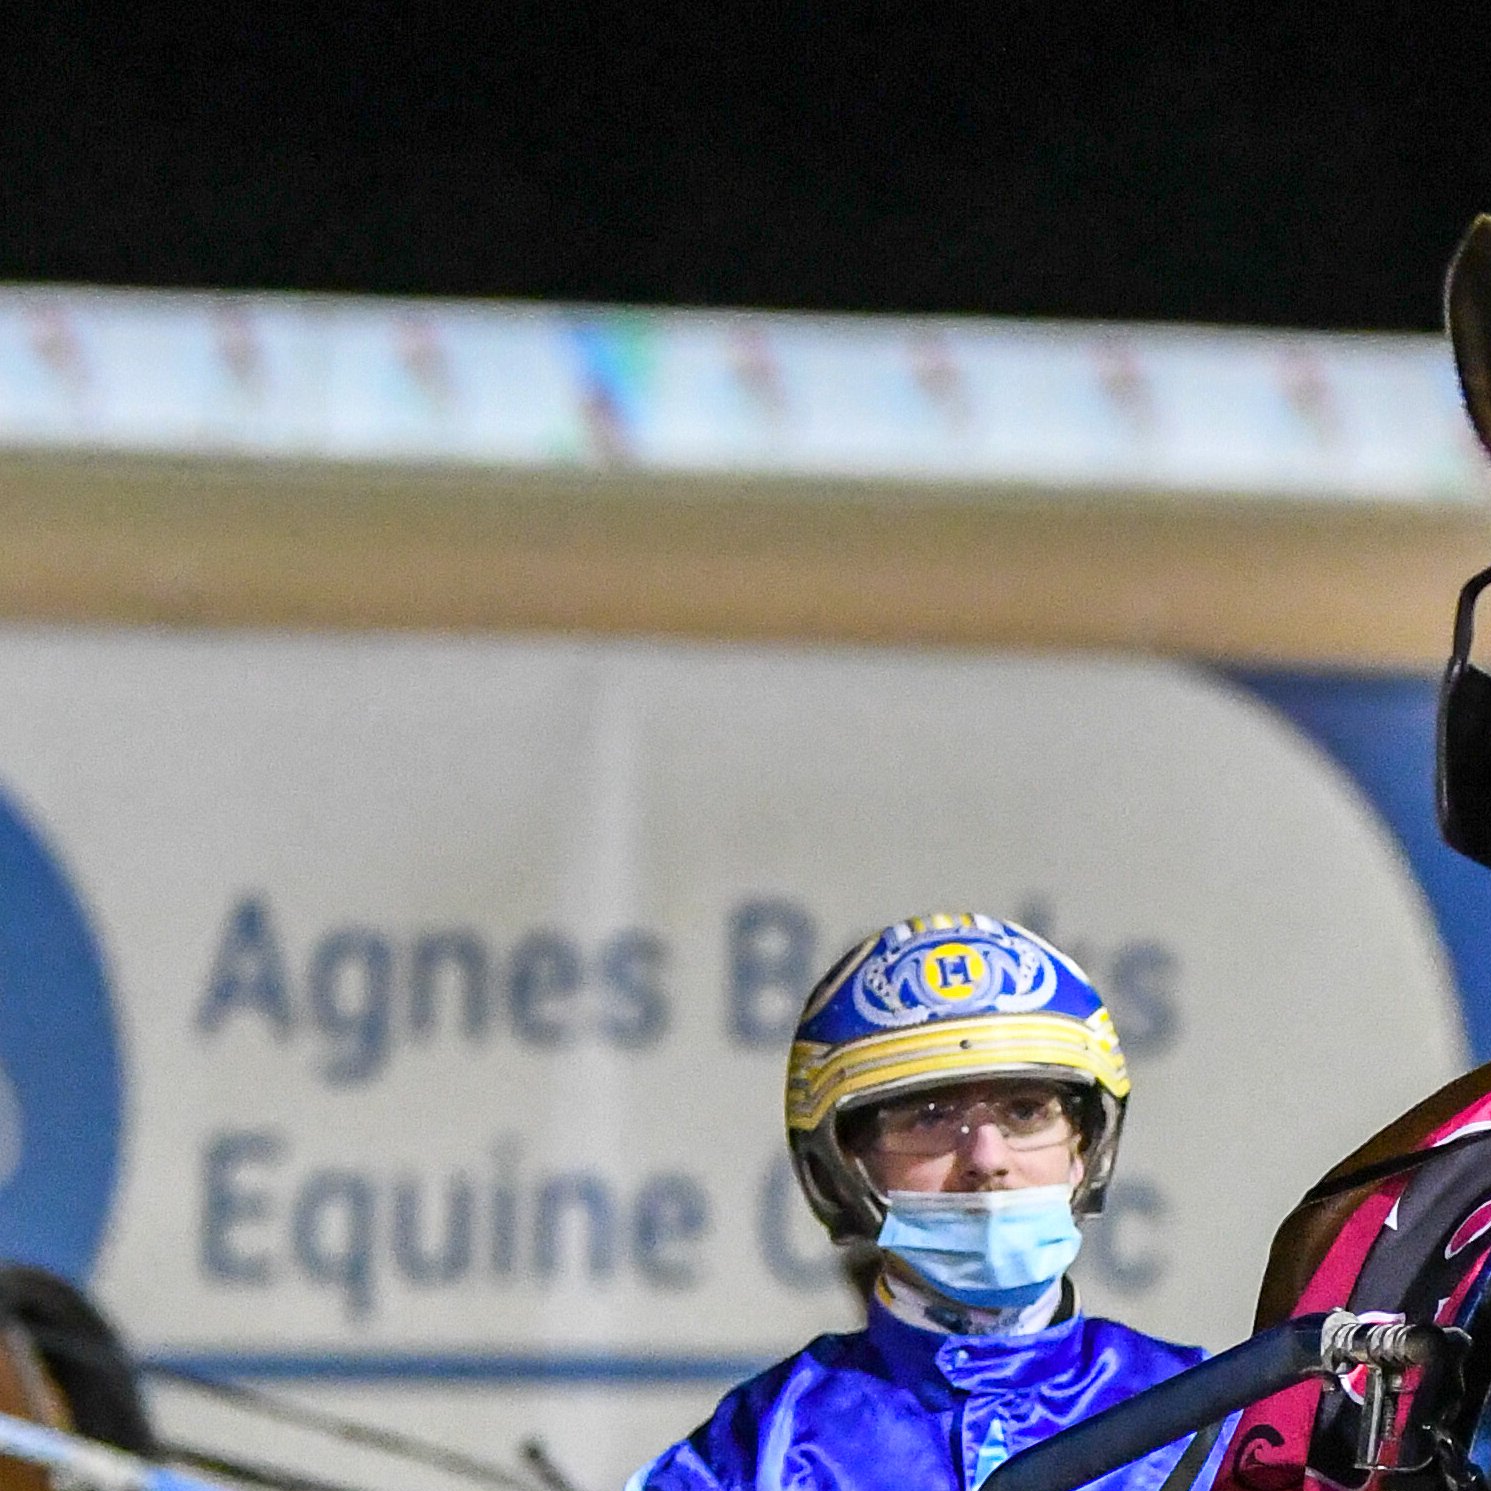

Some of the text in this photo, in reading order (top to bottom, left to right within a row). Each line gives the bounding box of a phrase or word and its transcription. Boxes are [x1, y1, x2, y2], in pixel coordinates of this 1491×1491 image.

[197, 893, 671, 1087] Agnes
[936, 955, 974, 988] H
[200, 1130, 707, 1321] Equine
